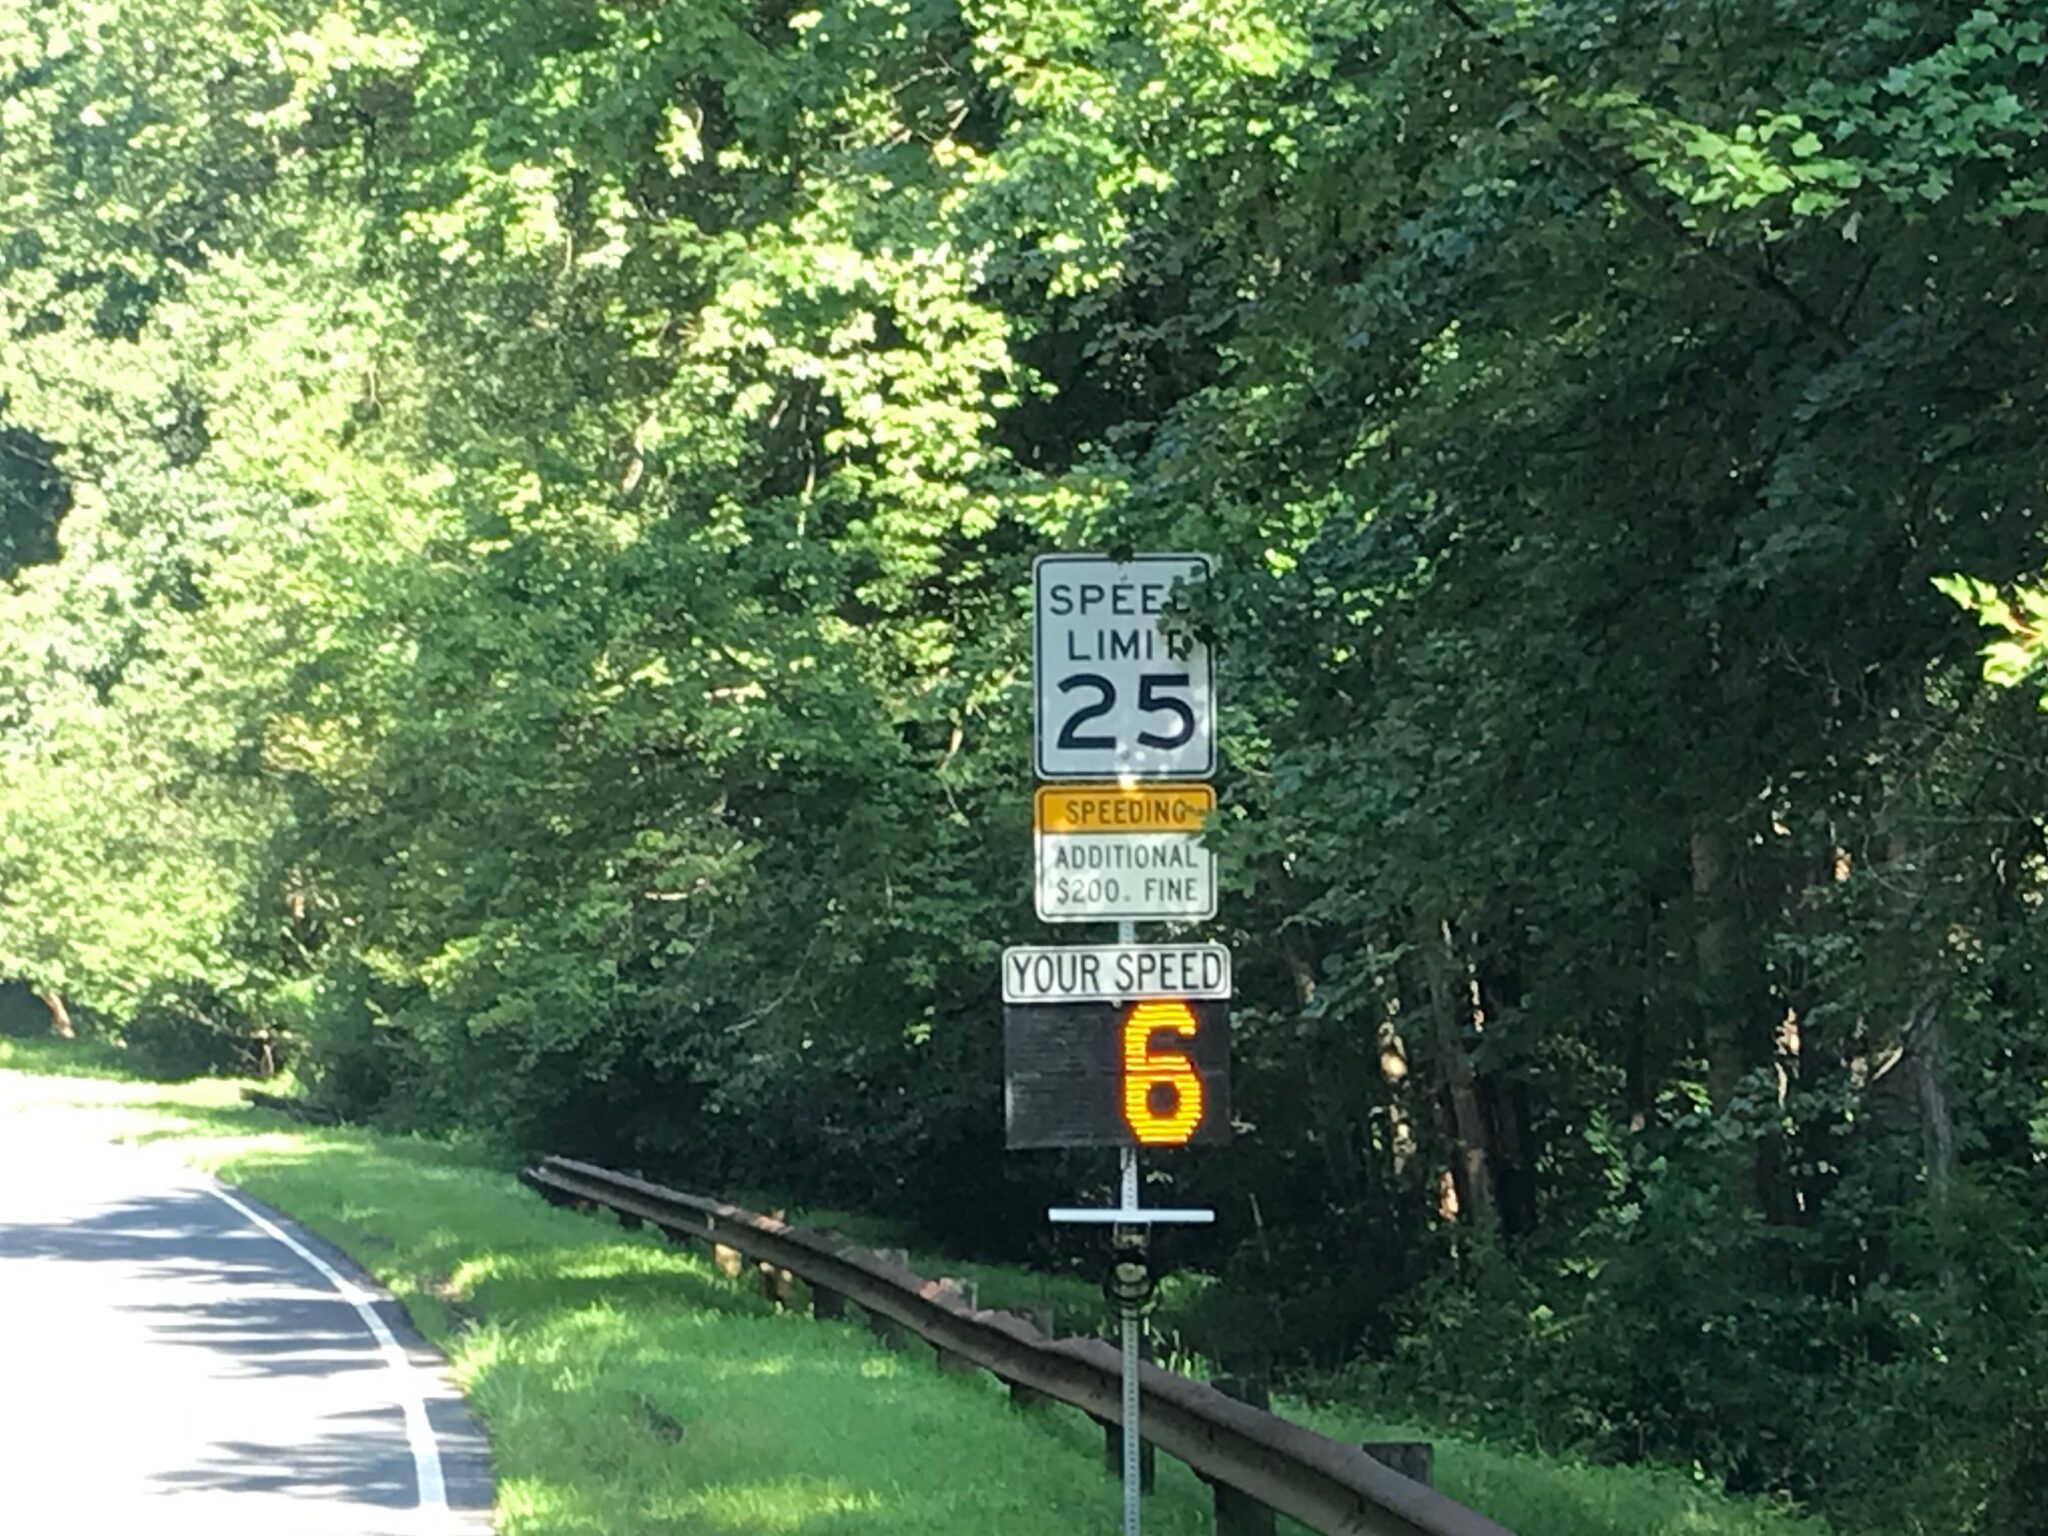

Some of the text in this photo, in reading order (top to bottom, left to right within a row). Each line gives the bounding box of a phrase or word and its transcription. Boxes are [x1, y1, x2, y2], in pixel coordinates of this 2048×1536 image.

[1057, 673, 1195, 750] 25
[1065, 799, 1187, 825] SPEEDING
[1056, 844, 1198, 870] ADDITIONAL
[1145, 878, 1198, 901] FINE
[1012, 952, 1222, 993] YOUR SPEED
[1125, 1002, 1202, 1143] 6
